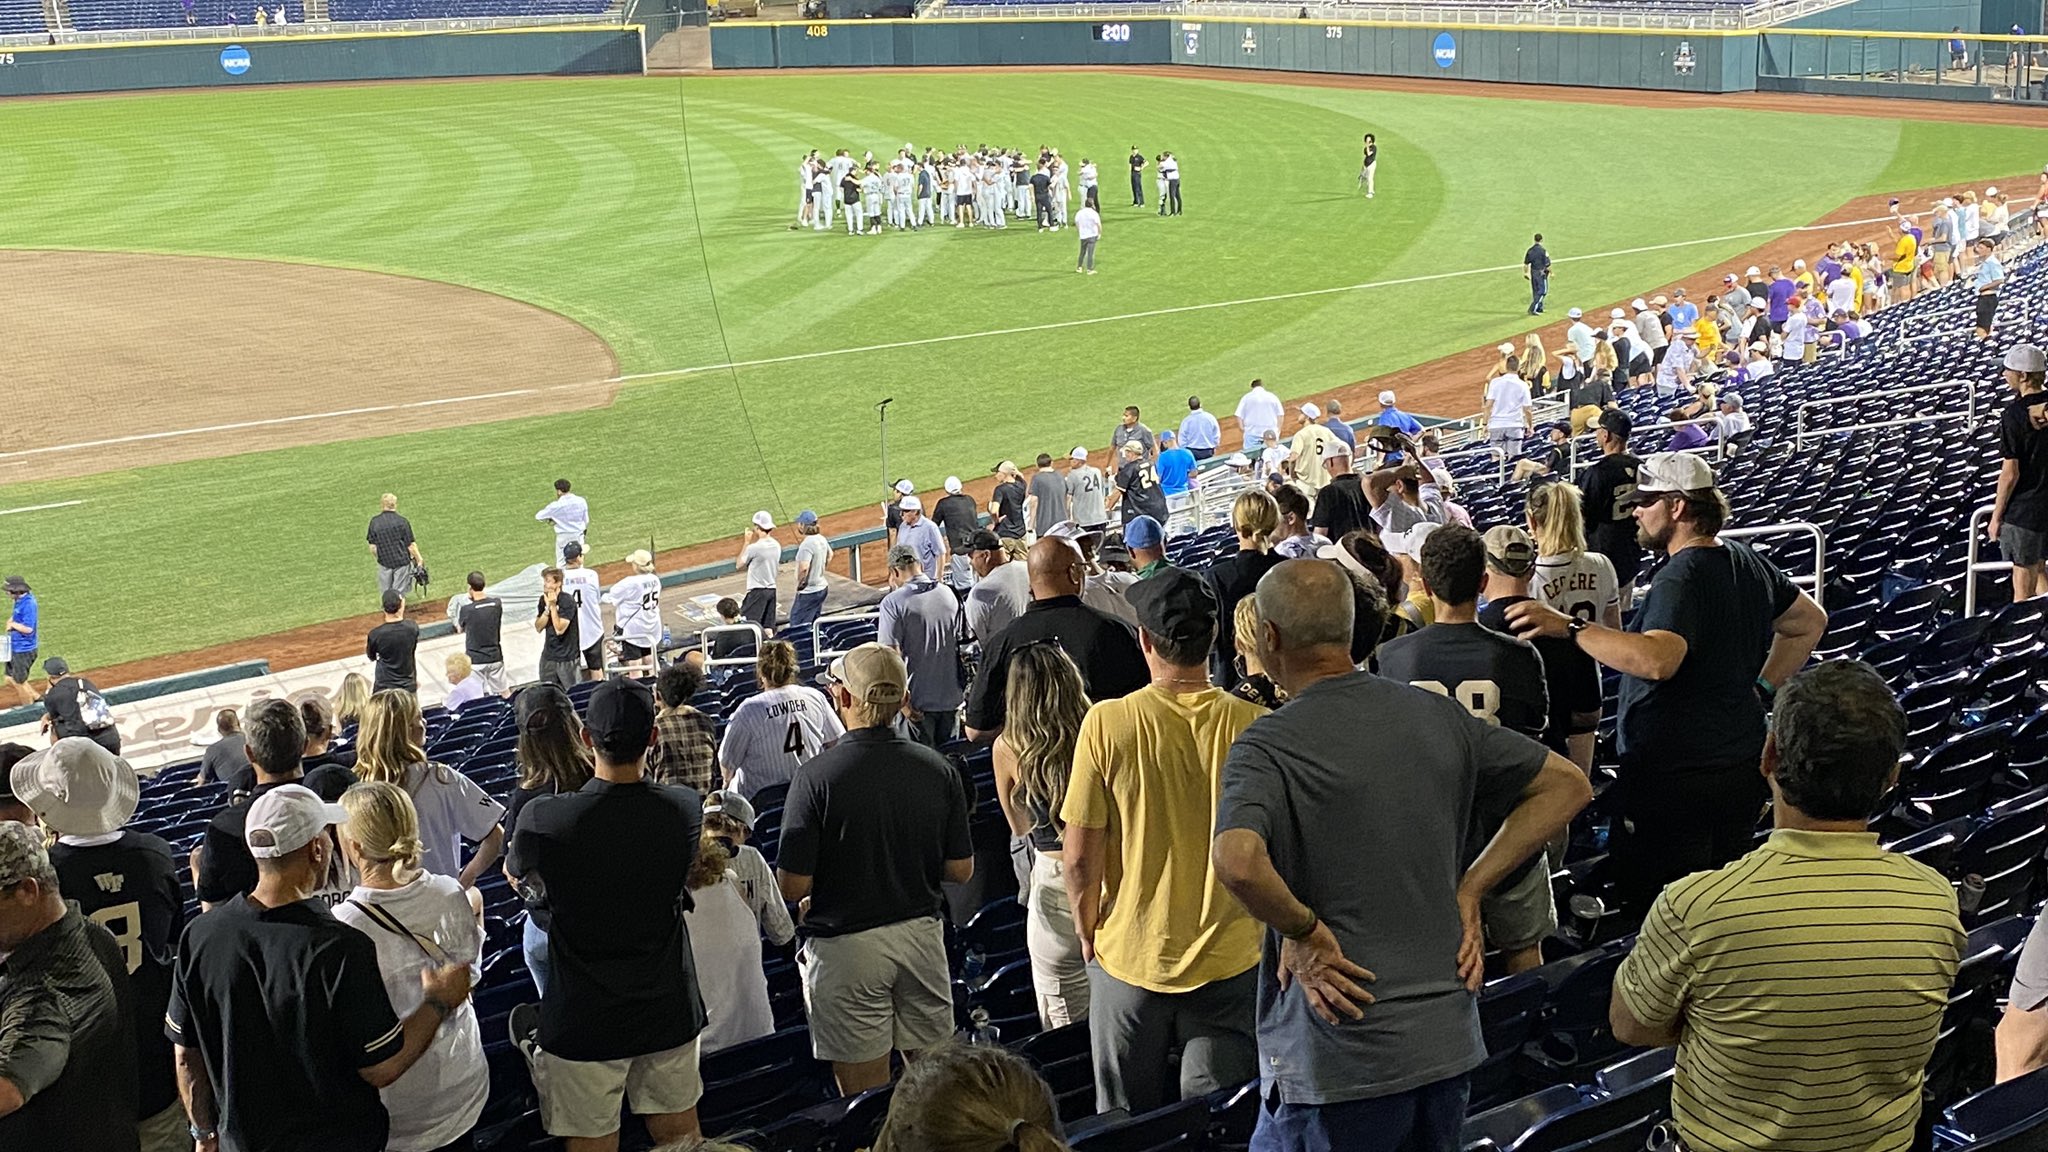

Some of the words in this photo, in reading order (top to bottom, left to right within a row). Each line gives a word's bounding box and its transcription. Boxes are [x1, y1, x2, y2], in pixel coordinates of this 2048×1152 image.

[806, 25, 828, 37] 408
[1102, 24, 1130, 41] 2:00
[1326, 26, 1343, 39] 375
[0, 53, 15, 64] 75
[1315, 437, 1324, 456] 6
[1083, 473, 1100, 493] 24
[1138, 465, 1160, 490] 24
[572, 588, 583, 608] 4
[641, 591, 660, 612] 25
[766, 699, 808, 719] LOWDER
[783, 721, 805, 757] 4
[93, 871, 125, 894] WF
